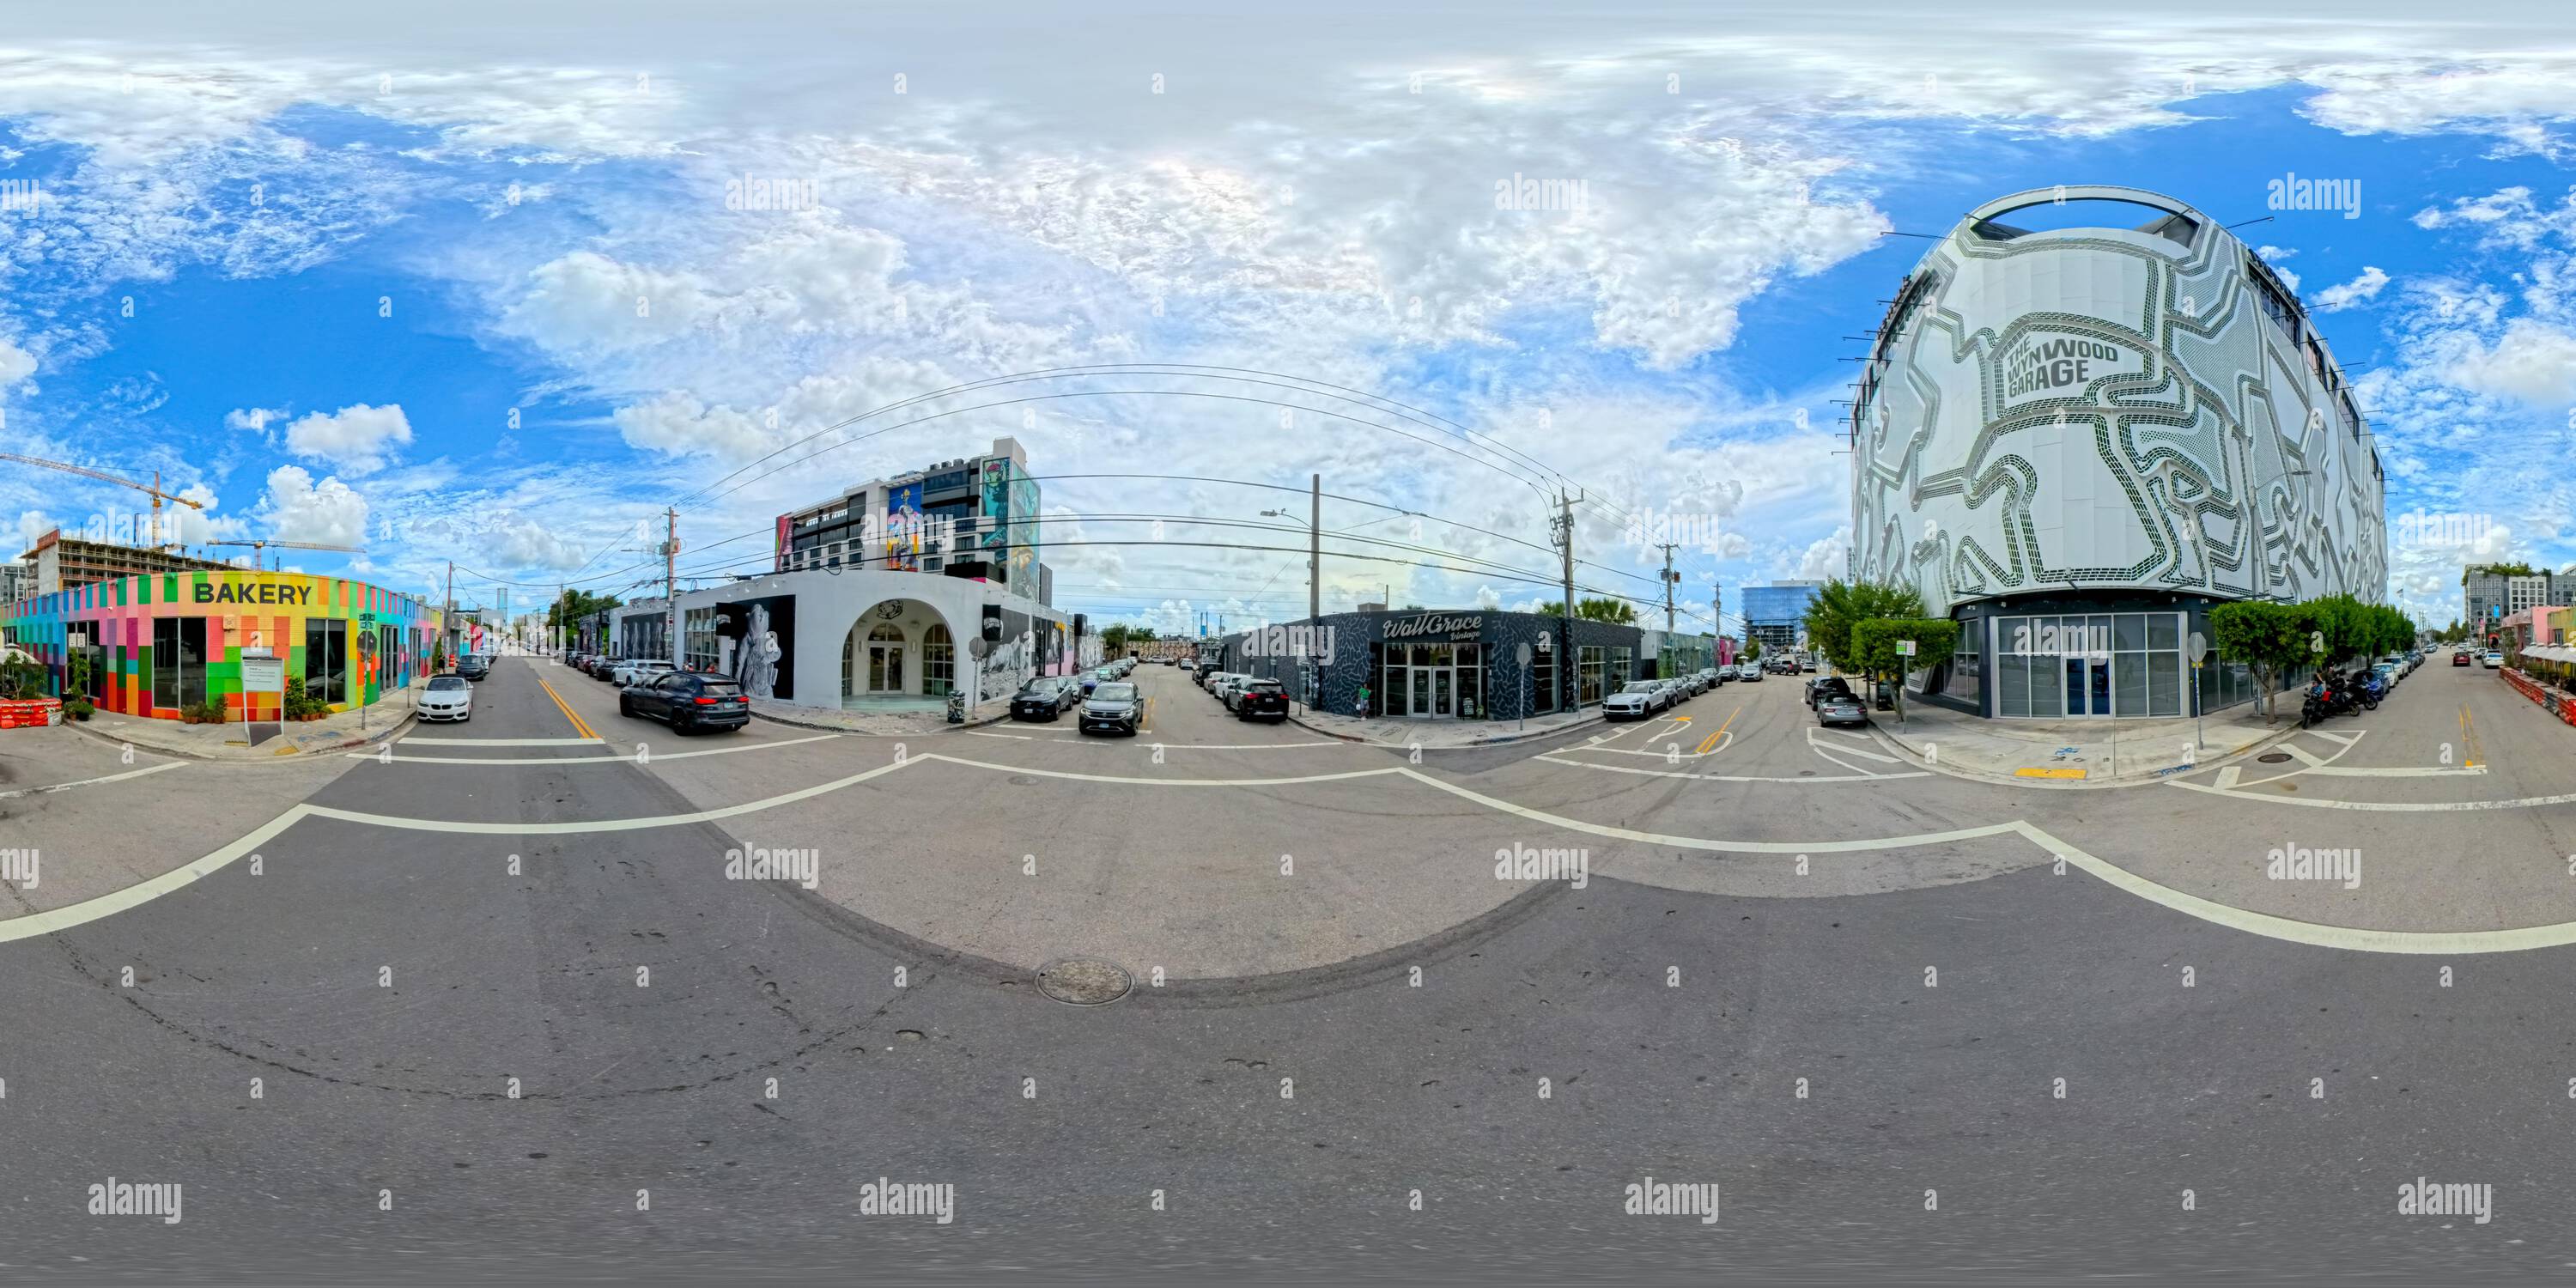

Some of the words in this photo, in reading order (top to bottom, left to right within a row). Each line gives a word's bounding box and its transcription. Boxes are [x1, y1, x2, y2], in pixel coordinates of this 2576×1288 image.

[2008, 335, 2031, 368] THE
[2008, 338, 2118, 384] WYNWOOD
[2008, 359, 2089, 398] GARAGE
[195, 583, 312, 605] BAKERY
[1450, 631, 1481, 641] Vintage
